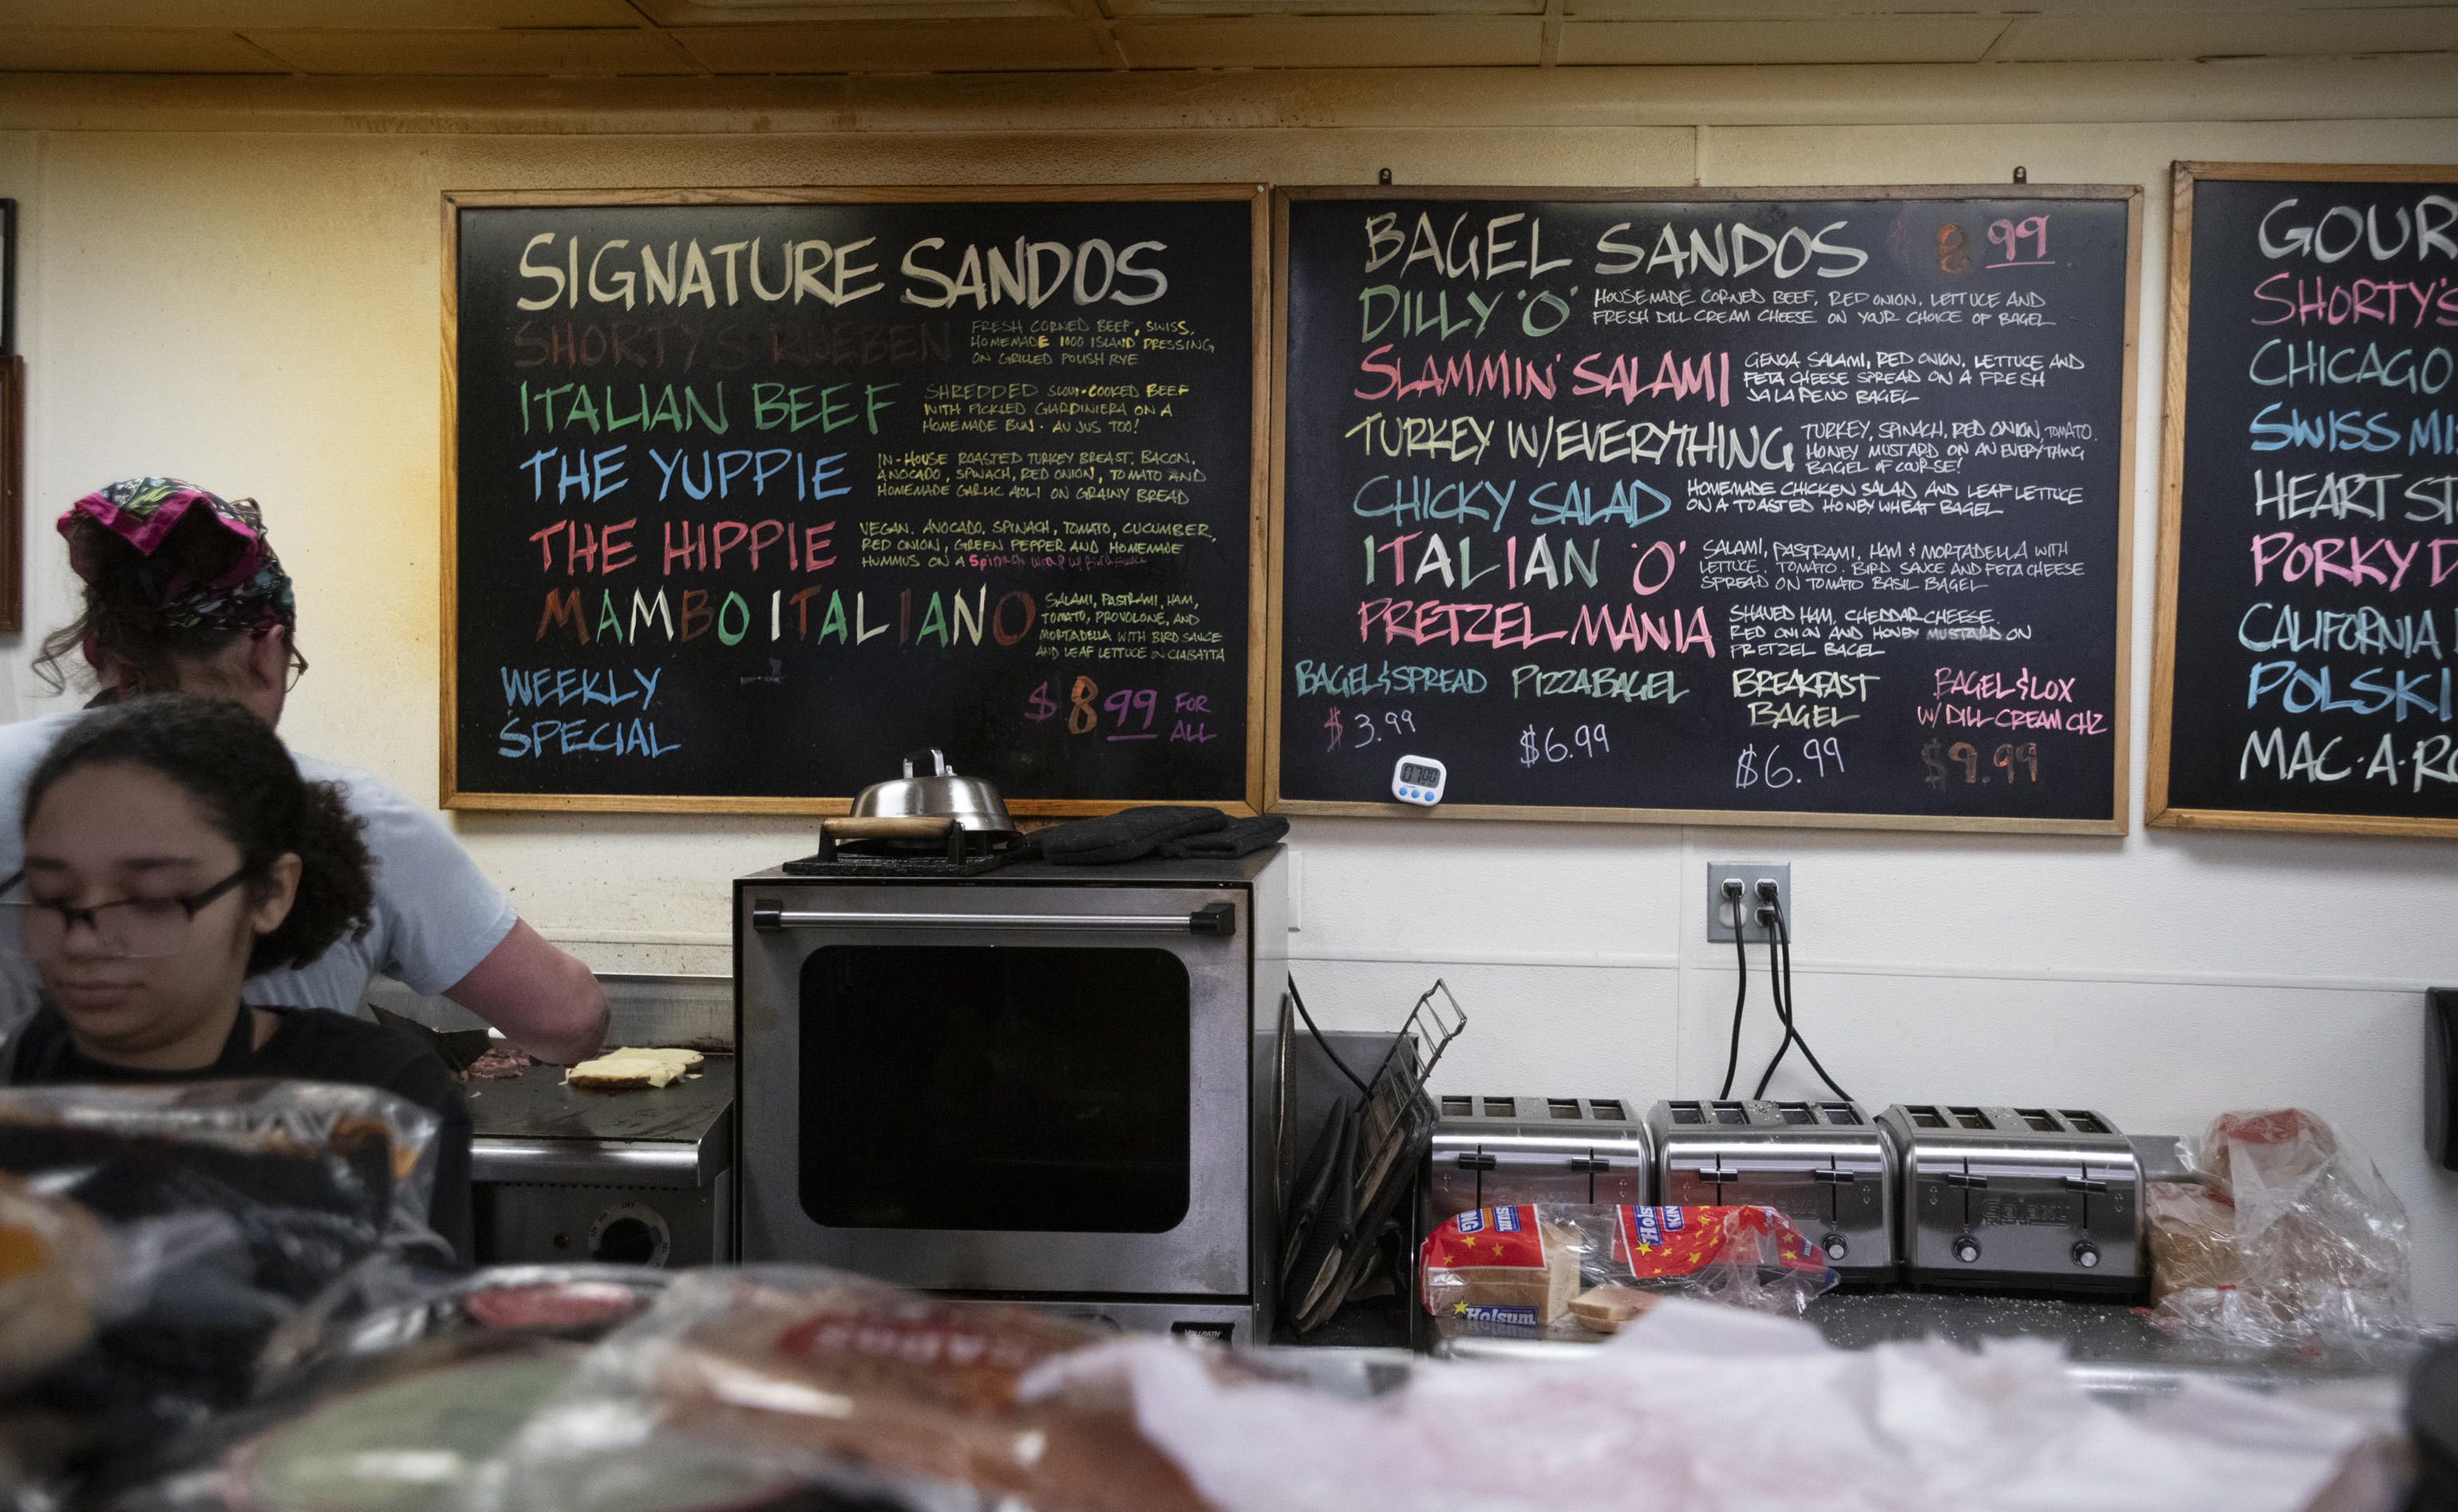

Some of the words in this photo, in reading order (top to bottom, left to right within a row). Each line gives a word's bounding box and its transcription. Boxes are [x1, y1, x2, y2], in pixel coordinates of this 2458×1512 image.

[1365, 211, 1573, 280] BAGEL
[1595, 221, 1868, 278] SANDOS
[516, 233, 884, 311] SIGNATURE
[900, 235, 1168, 310] SANDOS
[1701, 289, 1764, 305] CORNED
[1829, 292, 1870, 306] RED
[1931, 292, 2001, 307] LETTUCE
[2007, 292, 2045, 307] AND
[1359, 285, 1504, 342] DILLY
[1593, 310, 1649, 325] FRESH
[1656, 310, 1691, 324] DILL
[1694, 310, 1750, 323] CREAM
[1757, 310, 1817, 324] CHEESE
[1828, 310, 1847, 324] ON
[1907, 310, 1962, 324] CHOICE
[1972, 313, 1991, 326] OF
[1999, 313, 2056, 326] BAGEL
[972, 320, 1022, 334] FRESH
[1030, 318, 1089, 333] CORNED
[971, 335, 1049, 349] HOMEMADE
[1091, 337, 1136, 349] ISLAND
[1144, 338, 1215, 353] DRESSING
[972, 352, 991, 364] ON
[998, 353, 1053, 365] GRILLED
[1109, 353, 1140, 365] RYE
[1745, 352, 1800, 369] GENOA
[1877, 352, 1914, 368] RED
[1974, 355, 2043, 371] LETTUCE
[2049, 353, 2085, 369] AND
[2250, 338, 2453, 394] CHICAGO
[1573, 350, 1729, 408] SALAMI
[1744, 372, 1784, 388] FETA
[1790, 370, 1849, 385] CHEESE
[1857, 369, 1921, 385] SPREAD
[1928, 371, 1953, 385] ON
[1959, 369, 1972, 385] A
[1981, 372, 2045, 387] FRESH
[925, 384, 1037, 400] SHREDDED
[1146, 384, 1189, 397] BEEF
[1855, 389, 1920, 404] BAGEL
[521, 381, 728, 435] ITALIAN
[754, 383, 901, 435] BEEF
[924, 403, 961, 416] WITH
[969, 402, 1025, 416] PICKLED
[1134, 405, 1156, 416] ON
[1160, 403, 1173, 416] A
[923, 418, 997, 433] HOMEMADE
[1053, 420, 1071, 433] AU
[1077, 420, 1101, 433] JUS
[1951, 420, 1986, 439] RED
[2250, 402, 2401, 452] SWISS
[2409, 409, 2458, 456] MI
[1346, 412, 1495, 465] TURKEY
[958, 452, 1022, 466] ROASTED
[1806, 444, 1859, 460] HONEY
[1868, 443, 1938, 458] MUSTARD
[1947, 441, 1969, 456] ON
[1974, 441, 1996, 456] AN
[520, 444, 629, 504] THE
[650, 448, 852, 503] YUPPIE
[1021, 468, 1049, 480] RED
[1109, 469, 1163, 482] TOMATO
[1168, 468, 1206, 483] AND
[1805, 461, 1870, 475] BAGEL
[878, 483, 950, 497] HOMEMADE
[1050, 487, 1069, 499] ON
[1136, 488, 1189, 505] BREAD
[1688, 478, 1776, 497] HOMEMADE
[1780, 480, 1856, 498] CHICKEN
[1862, 480, 1918, 499] SALAD
[1924, 483, 1958, 497] AND
[1967, 484, 2012, 499] LEAF
[2015, 485, 2084, 505] LETTUCE
[2254, 469, 2402, 521] HEART
[2404, 476, 2458, 525] ST
[1353, 475, 1516, 532] CHICKY
[1529, 479, 1672, 528] SALAD
[1686, 497, 1712, 513] ON
[1716, 497, 1729, 513] A
[1733, 497, 1815, 514] TOASTED
[1823, 498, 1875, 515] HONEY
[1879, 499, 1935, 515] WHEAT
[1940, 500, 2004, 517] BAGEL
[530, 517, 637, 576] THE
[663, 519, 837, 575] HIPPIE
[862, 539, 891, 551] RED
[954, 539, 1003, 551] GREEN
[1011, 539, 1065, 551] PEPPER
[1070, 540, 1099, 553] AND
[1109, 541, 1184, 554] HOMEMADE
[1870, 542, 1902, 559] HAM
[2035, 541, 2068, 557] WITH
[862, 555, 920, 567] HUMMUS
[928, 555, 950, 567] ON
[1365, 531, 1601, 590] ITALIAN
[1851, 562, 1891, 575] BIRD
[1900, 562, 1946, 575] SAUCE
[1950, 563, 1982, 575] AND
[1985, 563, 2023, 577] FETA
[2027, 561, 2085, 577] CHEESE
[2251, 531, 2420, 591] PORKY
[1701, 574, 1768, 591] SPREAD
[1775, 576, 1800, 591] ON
[1806, 576, 1864, 591] TOMATO
[1872, 576, 1919, 590] BASIL
[1925, 577, 1989, 594] BAGEL
[1173, 614, 1199, 625] AND
[1358, 598, 1569, 649] PRETZEL
[1571, 603, 1716, 659] MANIA
[1118, 631, 1146, 642] WITH
[1730, 626, 1766, 640] RED
[1829, 626, 1863, 640] AND
[2006, 625, 2032, 641] ON
[2238, 602, 2442, 660] CALIFORNIA
[1036, 645, 1059, 660] AND
[1065, 646, 1094, 657] LEAF
[1099, 647, 1147, 659] LETTUCE
[1824, 643, 1886, 658] BAGEL
[501, 667, 661, 710] WEEKLY
[1733, 668, 1880, 701] BREAKFAST
[1934, 667, 2015, 700] BAGEL
[2248, 661, 2452, 722] POLSKI
[1176, 693, 1211, 714] FOR
[1749, 701, 1860, 728] BAGEL
[498, 717, 682, 758] SPECIAL
[1170, 719, 1217, 743] ALL
[1460, 1210, 1479, 1231] NG
[1637, 1206, 1659, 1243] Hols
[1665, 1206, 1681, 1228] KIN
[1465, 1308, 1536, 1325] Holsum
